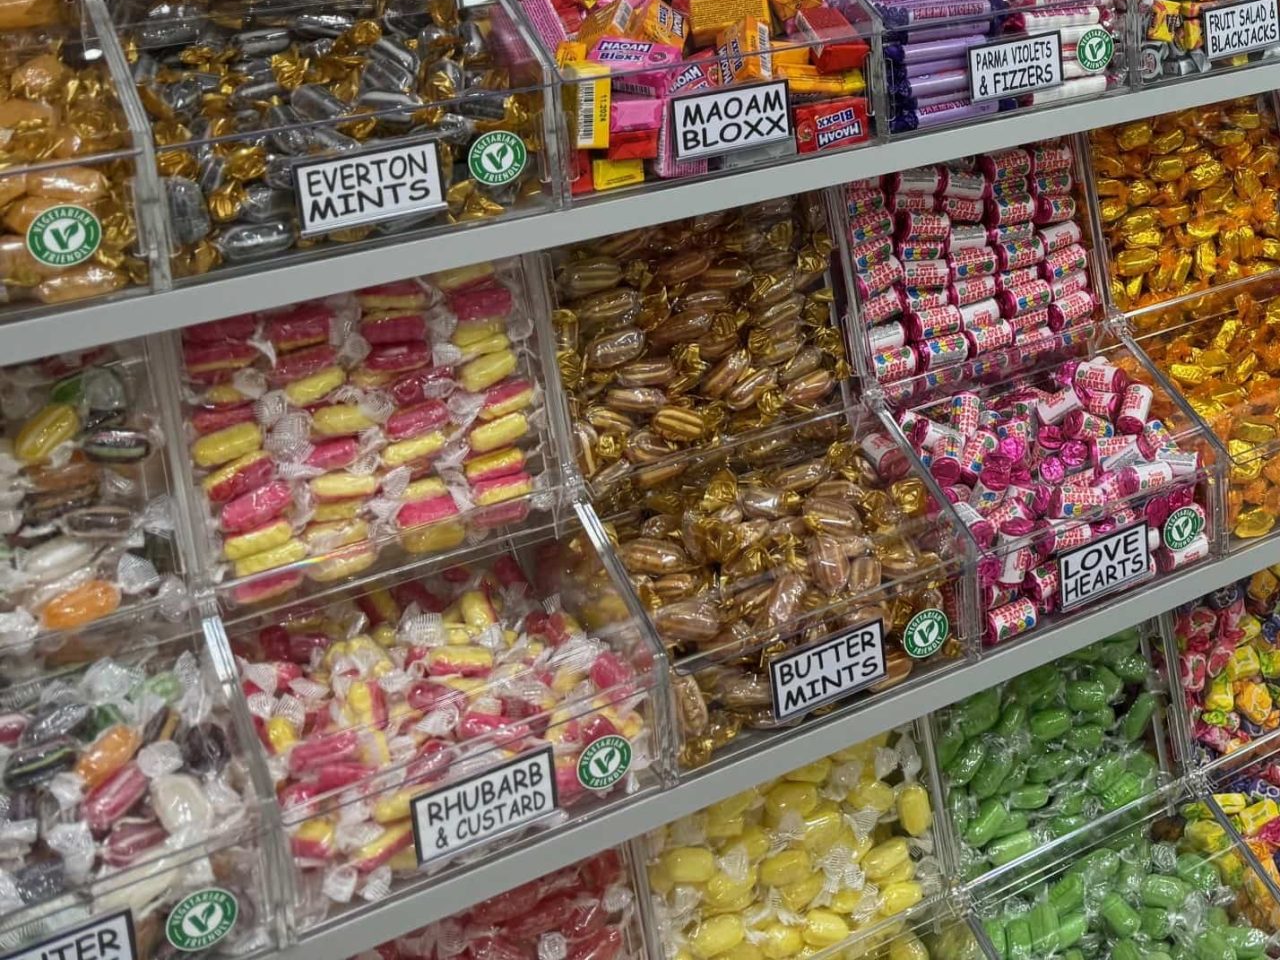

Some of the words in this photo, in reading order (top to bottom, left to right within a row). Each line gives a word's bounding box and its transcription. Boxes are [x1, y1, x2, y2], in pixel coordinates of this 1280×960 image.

[1209, 11, 1235, 34] FRUIT
[1239, 4, 1267, 27] SALAD
[1268, 3, 1276, 20] &
[598, 41, 652, 53] MAOAM
[600, 51, 643, 62] Bloxx
[976, 49, 1008, 71] PARMA
[1011, 40, 1052, 65] VIOLETS
[1211, 24, 1277, 54] BLACKJACKS
[979, 77, 988, 95] &
[994, 64, 1053, 92] FIZZERS
[683, 89, 784, 129] MAOAM
[682, 113, 786, 151] BLOXX
[818, 123, 861, 146] MAOAM
[306, 149, 429, 198] EVERTON
[309, 178, 432, 223] MINTS
[1064, 529, 1140, 582] LOVE
[1064, 554, 1144, 603] HEARTS
[778, 630, 877, 686] BUTTER
[784, 656, 879, 712] MINTS
[427, 761, 544, 827] RHUBARB
[435, 828, 449, 850] &
[456, 790, 547, 841] CUSTARD
